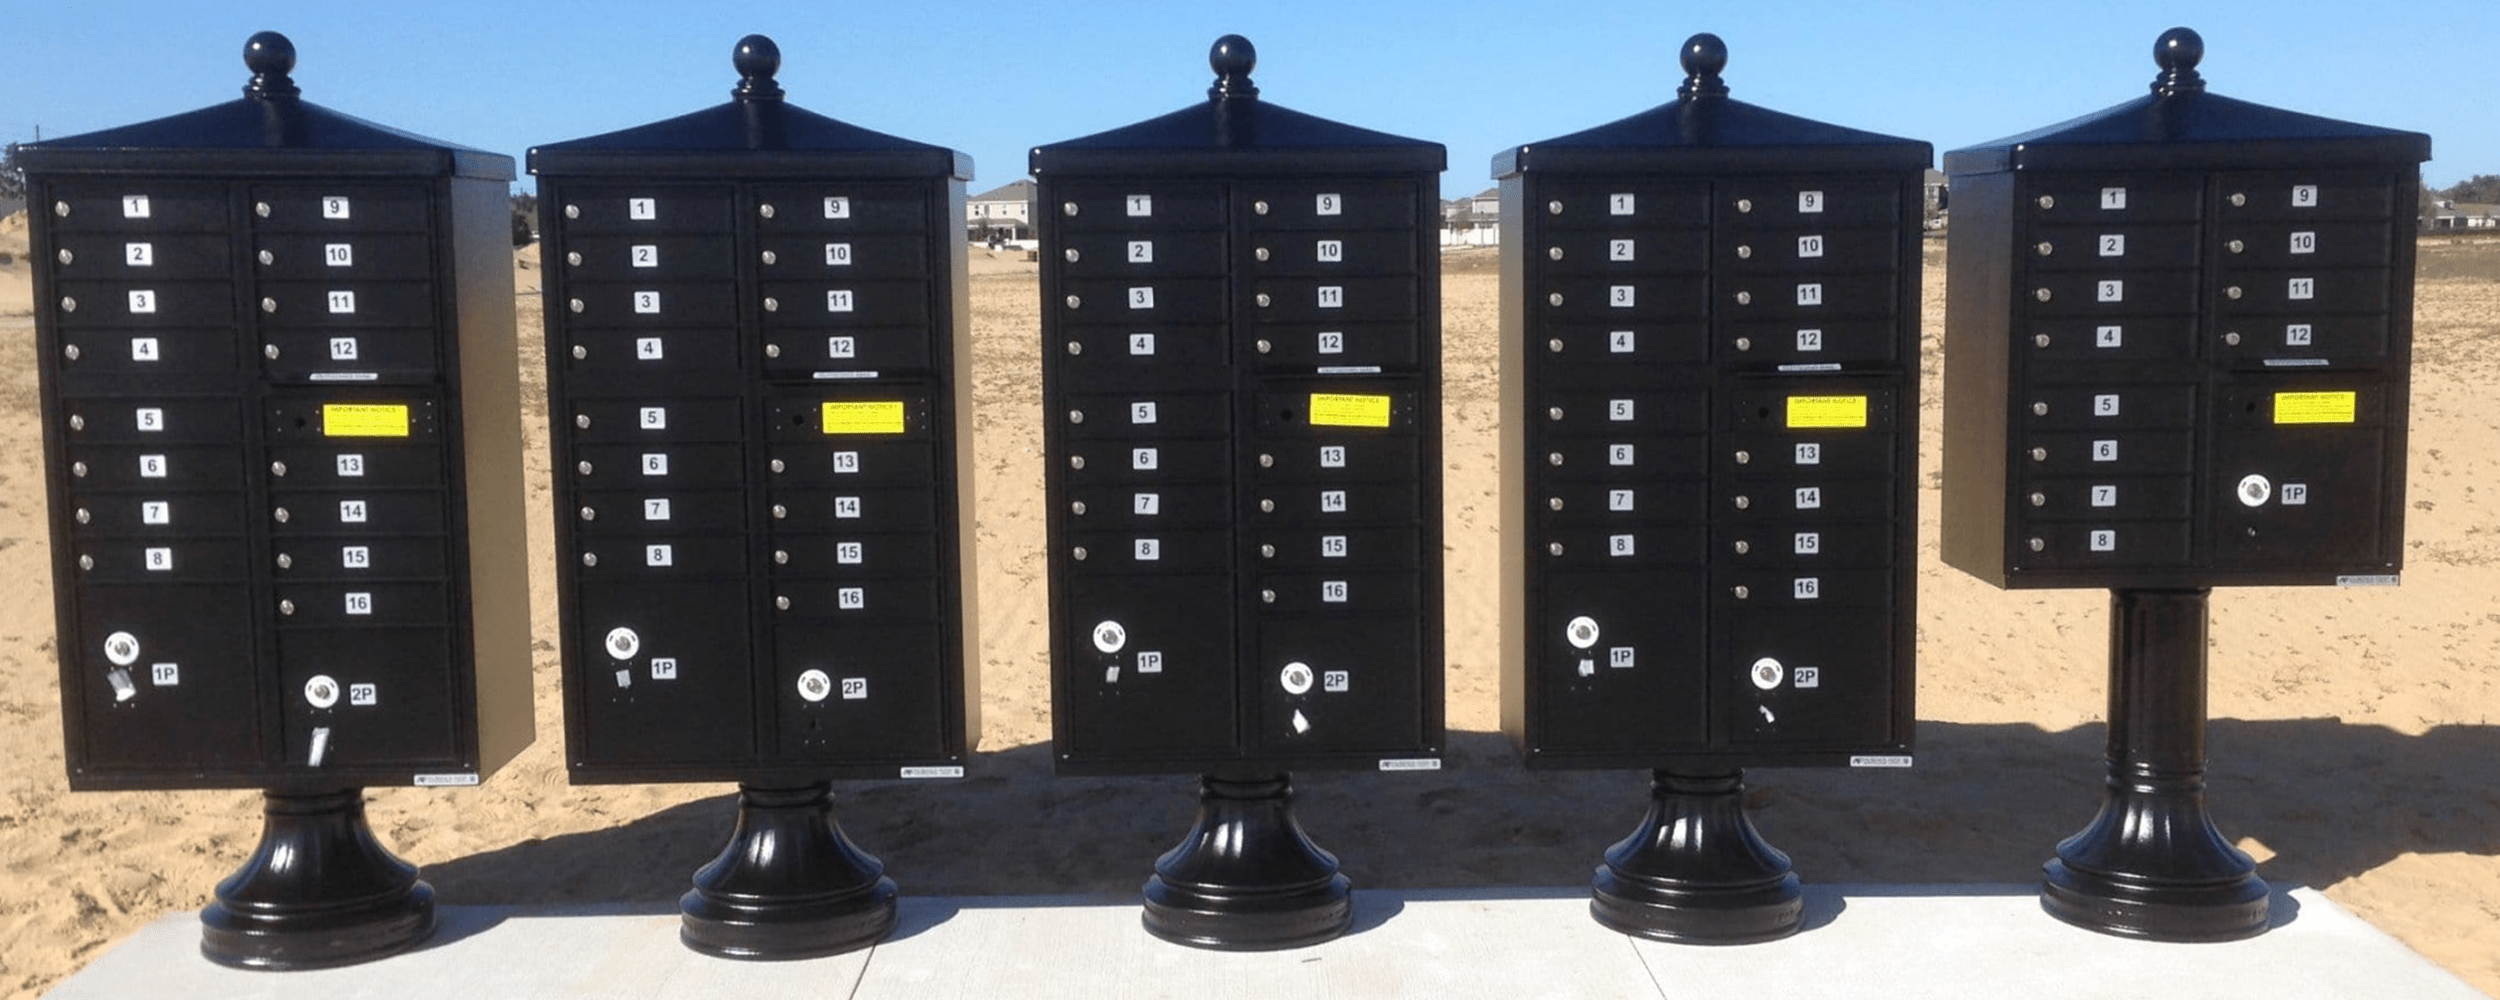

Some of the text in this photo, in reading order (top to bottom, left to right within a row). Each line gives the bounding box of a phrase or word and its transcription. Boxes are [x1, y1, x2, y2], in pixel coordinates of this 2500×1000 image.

[1805, 193, 1815, 208] 9
[2109, 190, 2116, 204] 1
[2299, 187, 2309, 202] 9
[131, 198, 139, 213] 1
[330, 199, 340, 214] 9
[637, 201, 645, 215] 1
[830, 199, 840, 214] 9
[1134, 198, 1142, 212] 1
[1322, 197, 1332, 211] 9
[1617, 196, 1624, 210] 1
[1616, 242, 1626, 256] 2
[1801, 238, 1819, 253] 10
[2106, 237, 2117, 252] 2
[2294, 235, 2312, 249] 10
[133, 246, 143, 261] 2
[329, 247, 348, 262] 10
[639, 248, 648, 262] 2
[829, 246, 847, 261] 10
[1134, 244, 1144, 258] 2
[1320, 243, 1338, 257] 10
[1617, 288, 1626, 302] 3
[1800, 286, 1816, 301] 11
[2105, 283, 2115, 298] 3
[2292, 281, 2309, 295] 11
[136, 294, 146, 308] 3
[332, 295, 349, 308] 11
[641, 294, 651, 309] 3
[830, 293, 847, 307] 11
[1135, 290, 1145, 304] 3
[1320, 289, 1337, 303] 11
[1616, 334, 1626, 347] 4
[1799, 332, 1818, 346] 12
[2103, 329, 2114, 343] 4
[2290, 327, 2308, 341] 12
[333, 341, 353, 355] 12
[643, 341, 654, 355] 4
[832, 339, 850, 353] 12
[1136, 336, 1146, 350] 4
[1321, 334, 1339, 349] 12
[139, 342, 149, 356] 4
[1616, 402, 1625, 416] 5
[2102, 397, 2112, 412] 5
[144, 412, 154, 426] 5
[647, 410, 657, 424] 5
[1138, 405, 1148, 419] 5
[1323, 449, 1342, 463] 13
[1616, 447, 1625, 461] 6
[1798, 446, 1816, 460] 13
[2100, 443, 2110, 457] 6
[340, 458, 359, 472] 13
[648, 456, 659, 471] 6
[836, 454, 855, 468] 13
[1139, 451, 1149, 465] 6
[147, 459, 158, 473] 6
[1324, 494, 1342, 507] 14
[1616, 492, 1625, 506] 7
[1799, 490, 1817, 504] 14
[2099, 489, 2109, 502] 7
[2284, 487, 2304, 500] 1P
[651, 501, 661, 515] 7
[838, 500, 856, 513] 14
[1141, 496, 1151, 510] 7
[150, 505, 159, 519] 7
[343, 504, 362, 518] 14
[1325, 538, 1343, 553] 15
[1616, 538, 1626, 552] 8
[1797, 535, 1816, 549] 15
[2097, 533, 2108, 547] 8
[653, 547, 663, 562] 8
[840, 545, 858, 559] 15
[1141, 542, 1151, 556] 8
[153, 552, 163, 565] 8
[346, 550, 365, 564] 15
[1326, 584, 1344, 598] 16
[1797, 580, 1815, 594] 16
[349, 596, 368, 610] 16
[841, 591, 860, 605] 16
[1139, 654, 1159, 668] 1P
[1612, 649, 1632, 663] 1P
[155, 667, 175, 681] 1P
[653, 661, 673, 675] 1P
[1325, 673, 1346, 687] 2P
[1795, 669, 1816, 683] 2P
[352, 687, 373, 701] 2P
[843, 681, 864, 695] 2P
